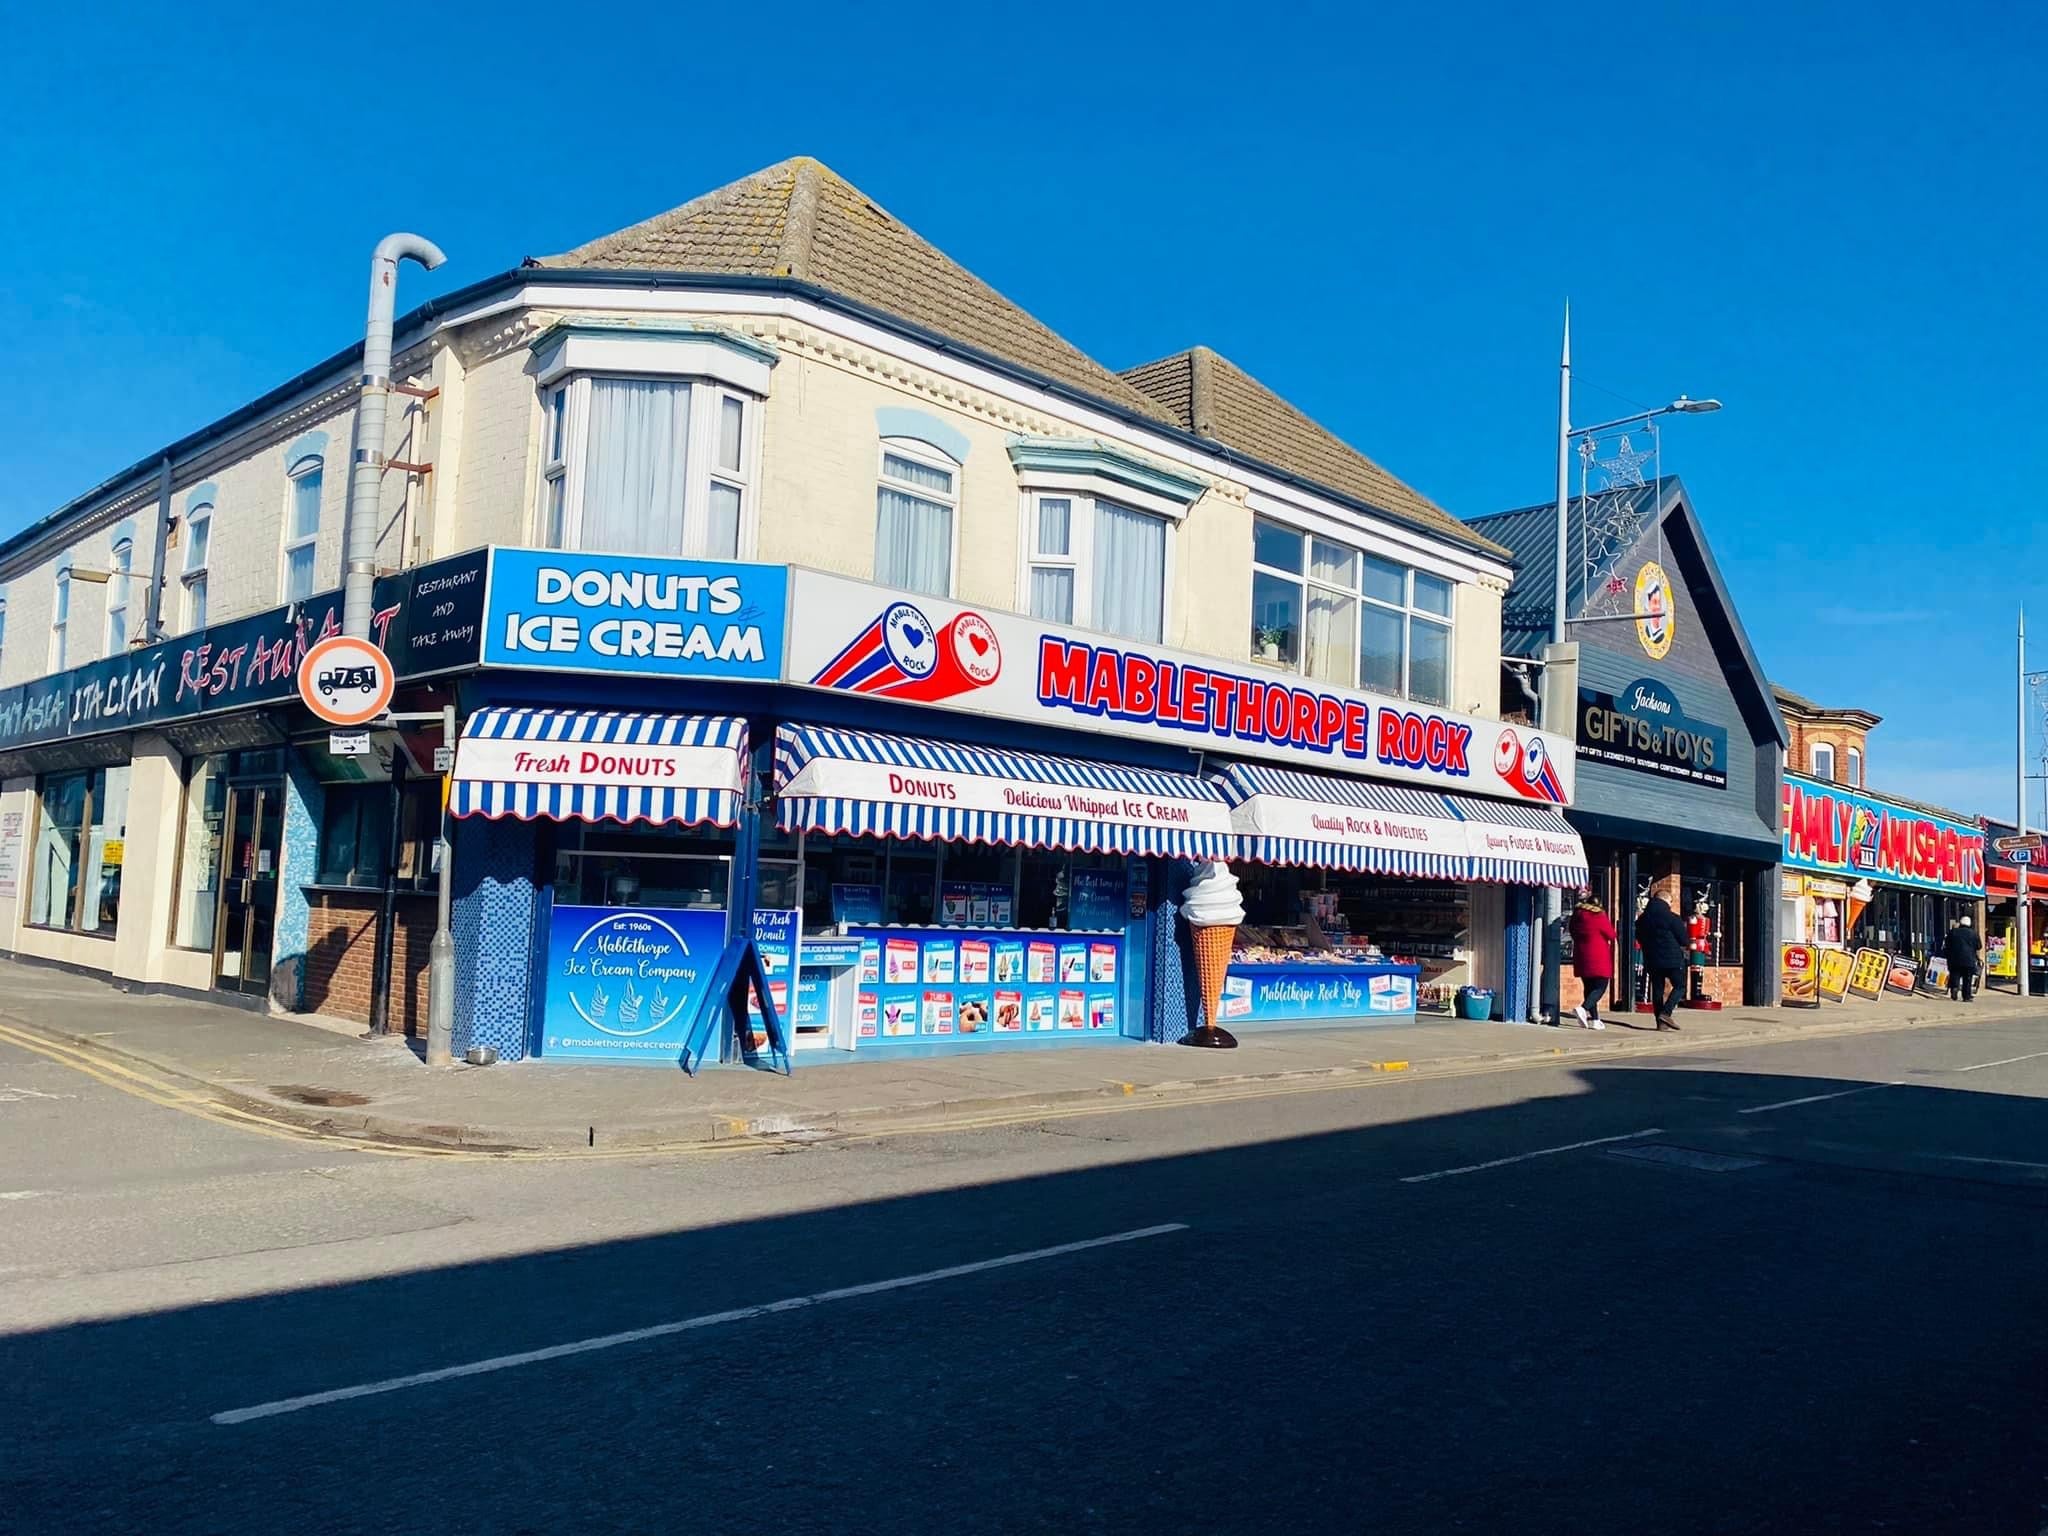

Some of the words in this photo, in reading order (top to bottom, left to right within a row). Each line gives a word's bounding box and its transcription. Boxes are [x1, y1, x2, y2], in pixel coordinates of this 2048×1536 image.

[415, 569, 479, 599] RESTAURANT
[537, 567, 742, 615] DONUTS
[431, 601, 455, 618] AND
[411, 632, 437, 649] TAKE
[441, 624, 475, 643] AWAY
[505, 613, 580, 654] ICE
[588, 619, 765, 663] CREAM
[889, 608, 933, 644] MABLETHORPE
[0, 690, 65, 737] NTASIA
[72, 657, 166, 722] ITALIAN
[175, 602, 401, 702] RESTAURAT
[903, 655, 926, 671] ROCK
[969, 663, 991, 678] ROCK
[1038, 634, 1369, 759] MABLETHORPE
[1378, 706, 1472, 777] ROCK
[1631, 686, 1671, 714] Jacksons
[515, 751, 570, 774] Fresh
[579, 751, 677, 777] DONUTS
[888, 772, 957, 801] DONUTS
[1003, 787, 1062, 812] Delicious
[1064, 794, 1119, 819] Whipped
[1122, 799, 1143, 820] ICE
[1146, 802, 1189, 824] CREAM
[1312, 813, 1345, 836] Quality
[1346, 816, 1372, 834] ROCK
[1373, 819, 1382, 836] &
[1383, 821, 1429, 841] NOVELTIES
[1508, 834, 1534, 851] FUDGE
[1534, 837, 1542, 852] &
[1876, 808, 1984, 890] AMUSEMENTS
[629, 922, 652, 932] 1960s
[755, 927, 786, 941] Donuts
[588, 934, 672, 960] Mablethorpe
[563, 957, 587, 977] Ice
[591, 957, 634, 977] Cream
[636, 958, 697, 984] Company
[1259, 980, 1315, 1010] Mablethorpe
[1317, 981, 1340, 1001] Rock
[1341, 980, 1362, 1009] Shop
